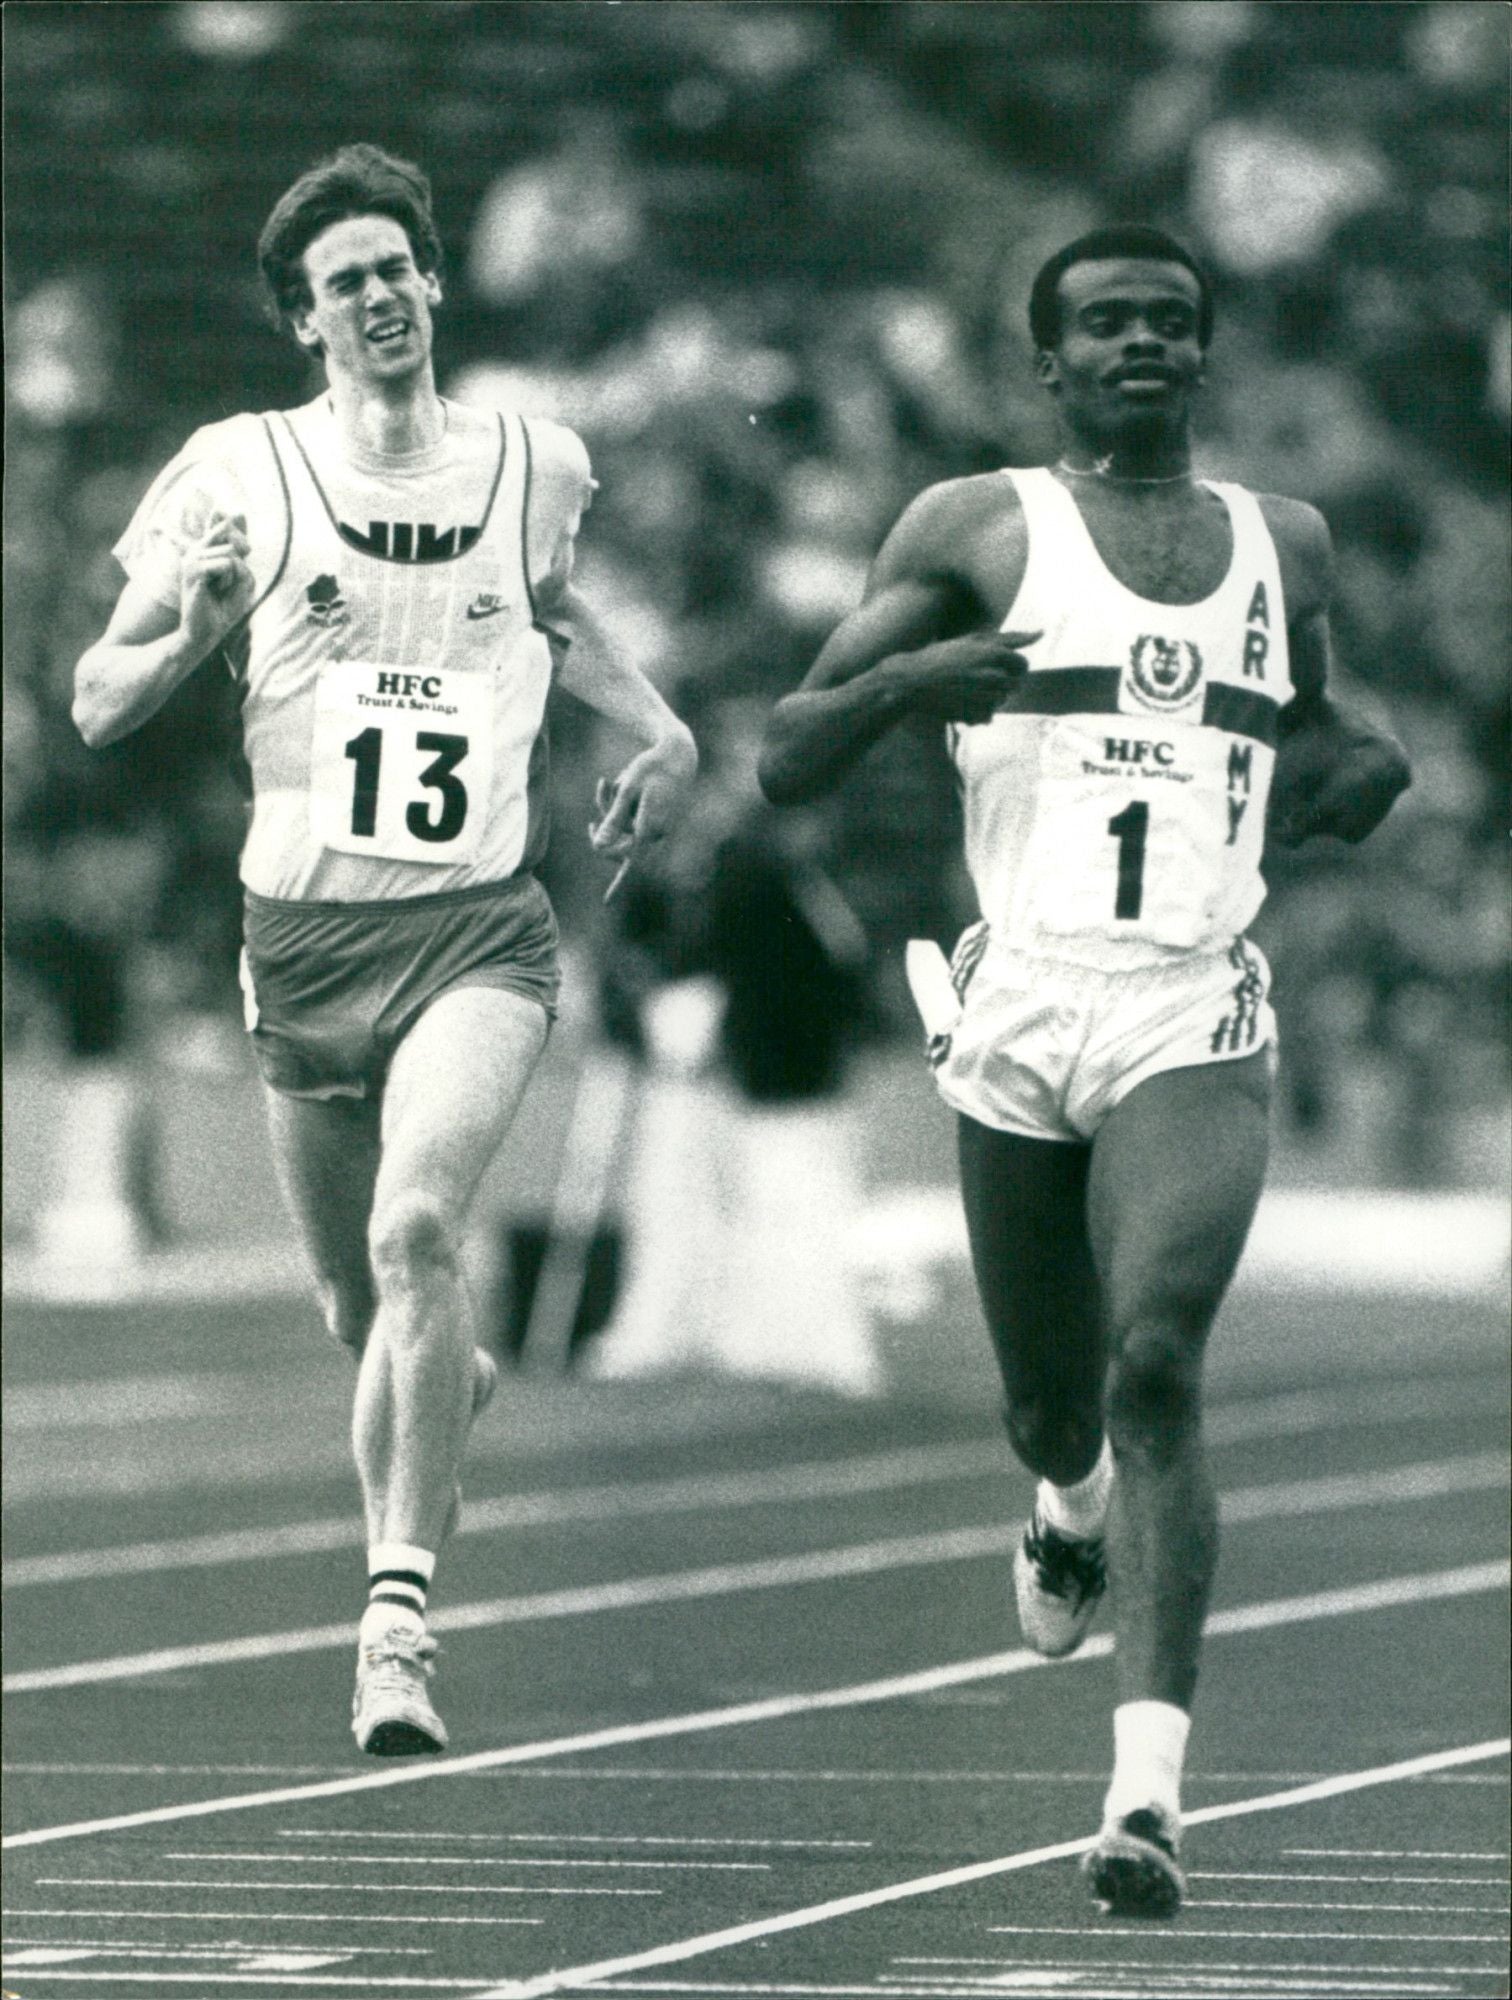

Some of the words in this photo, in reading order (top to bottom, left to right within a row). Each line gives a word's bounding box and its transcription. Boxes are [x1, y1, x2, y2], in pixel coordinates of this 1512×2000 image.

[376, 671, 442, 699] HFC
[357, 693, 393, 708] Trust
[396, 699, 405, 709] &
[409, 698, 458, 716] Savings
[1103, 737, 1175, 766] HFC
[344, 727, 470, 843] 13
[1081, 759, 1122, 777] Trust
[1140, 766, 1195, 784] Savings
[1107, 800, 1149, 920] 1
